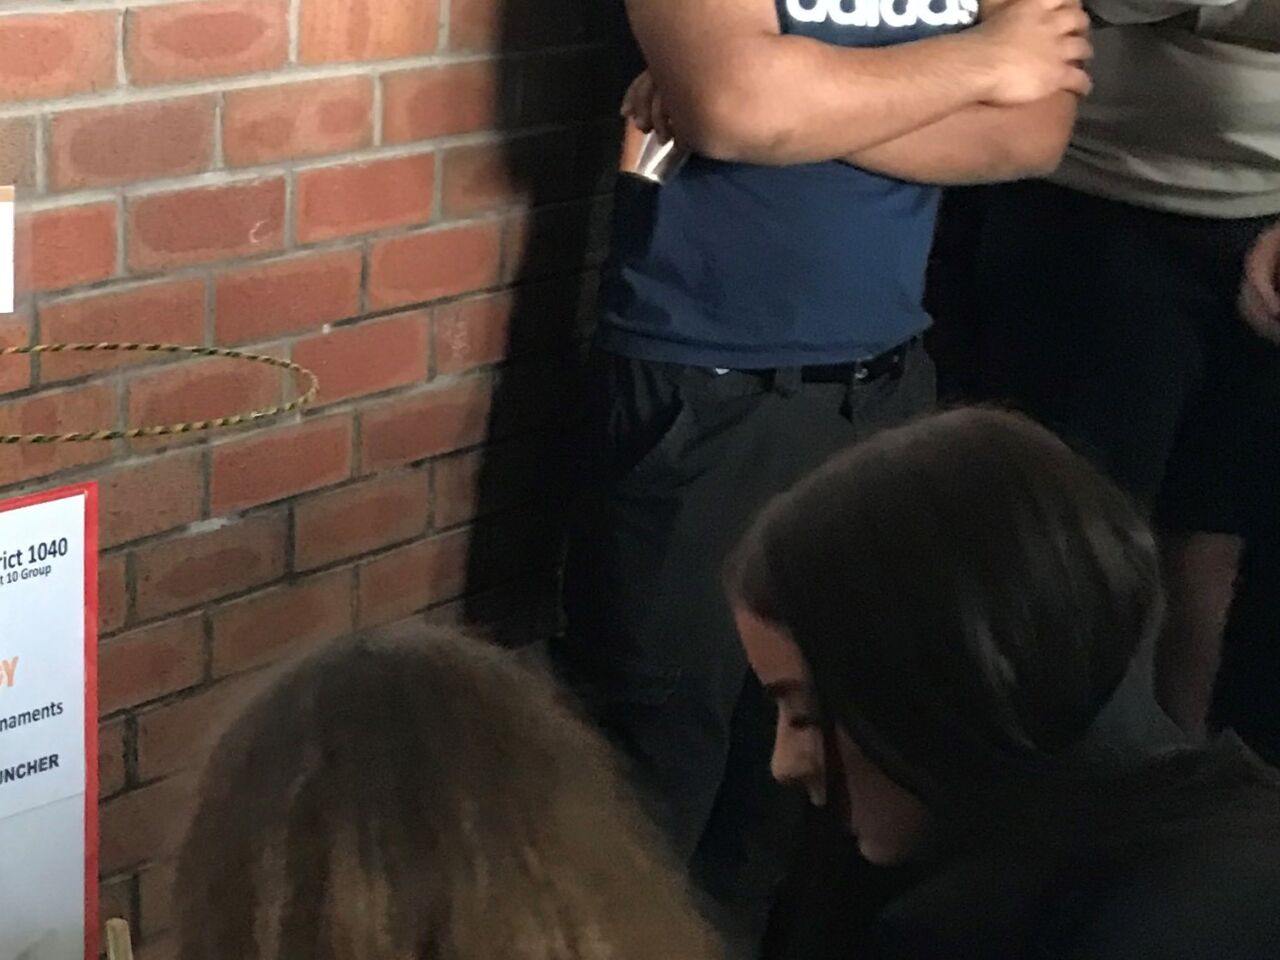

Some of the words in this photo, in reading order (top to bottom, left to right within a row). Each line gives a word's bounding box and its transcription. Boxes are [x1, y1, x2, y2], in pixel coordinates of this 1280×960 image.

[28, 537, 68, 564] 1040
[6, 570, 19, 585] 10
[20, 564, 52, 578] Group
